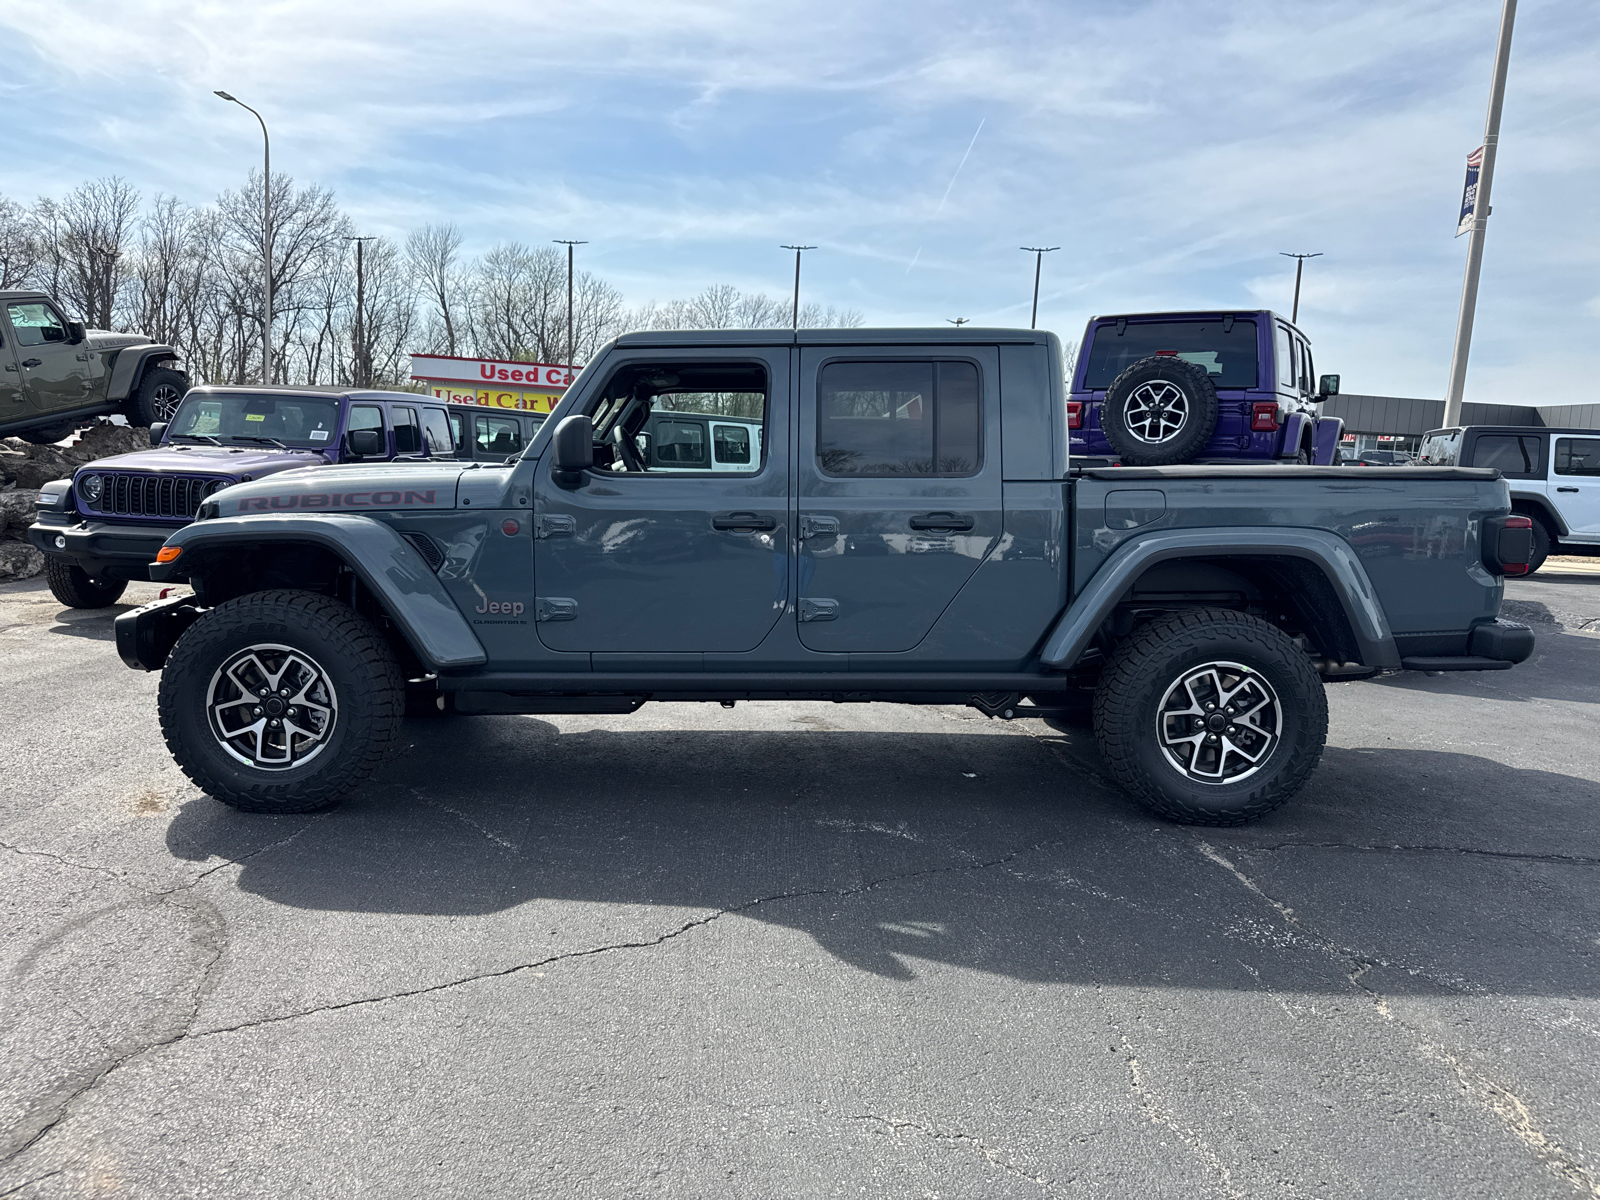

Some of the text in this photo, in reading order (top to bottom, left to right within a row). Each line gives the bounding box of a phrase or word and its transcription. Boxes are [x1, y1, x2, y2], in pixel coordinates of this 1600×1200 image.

[480, 364, 538, 382] Used
[434, 389, 489, 406] Used
[496, 393, 538, 411] Car
[238, 490, 436, 511] RUBICON
[475, 597, 525, 617] Jeep
